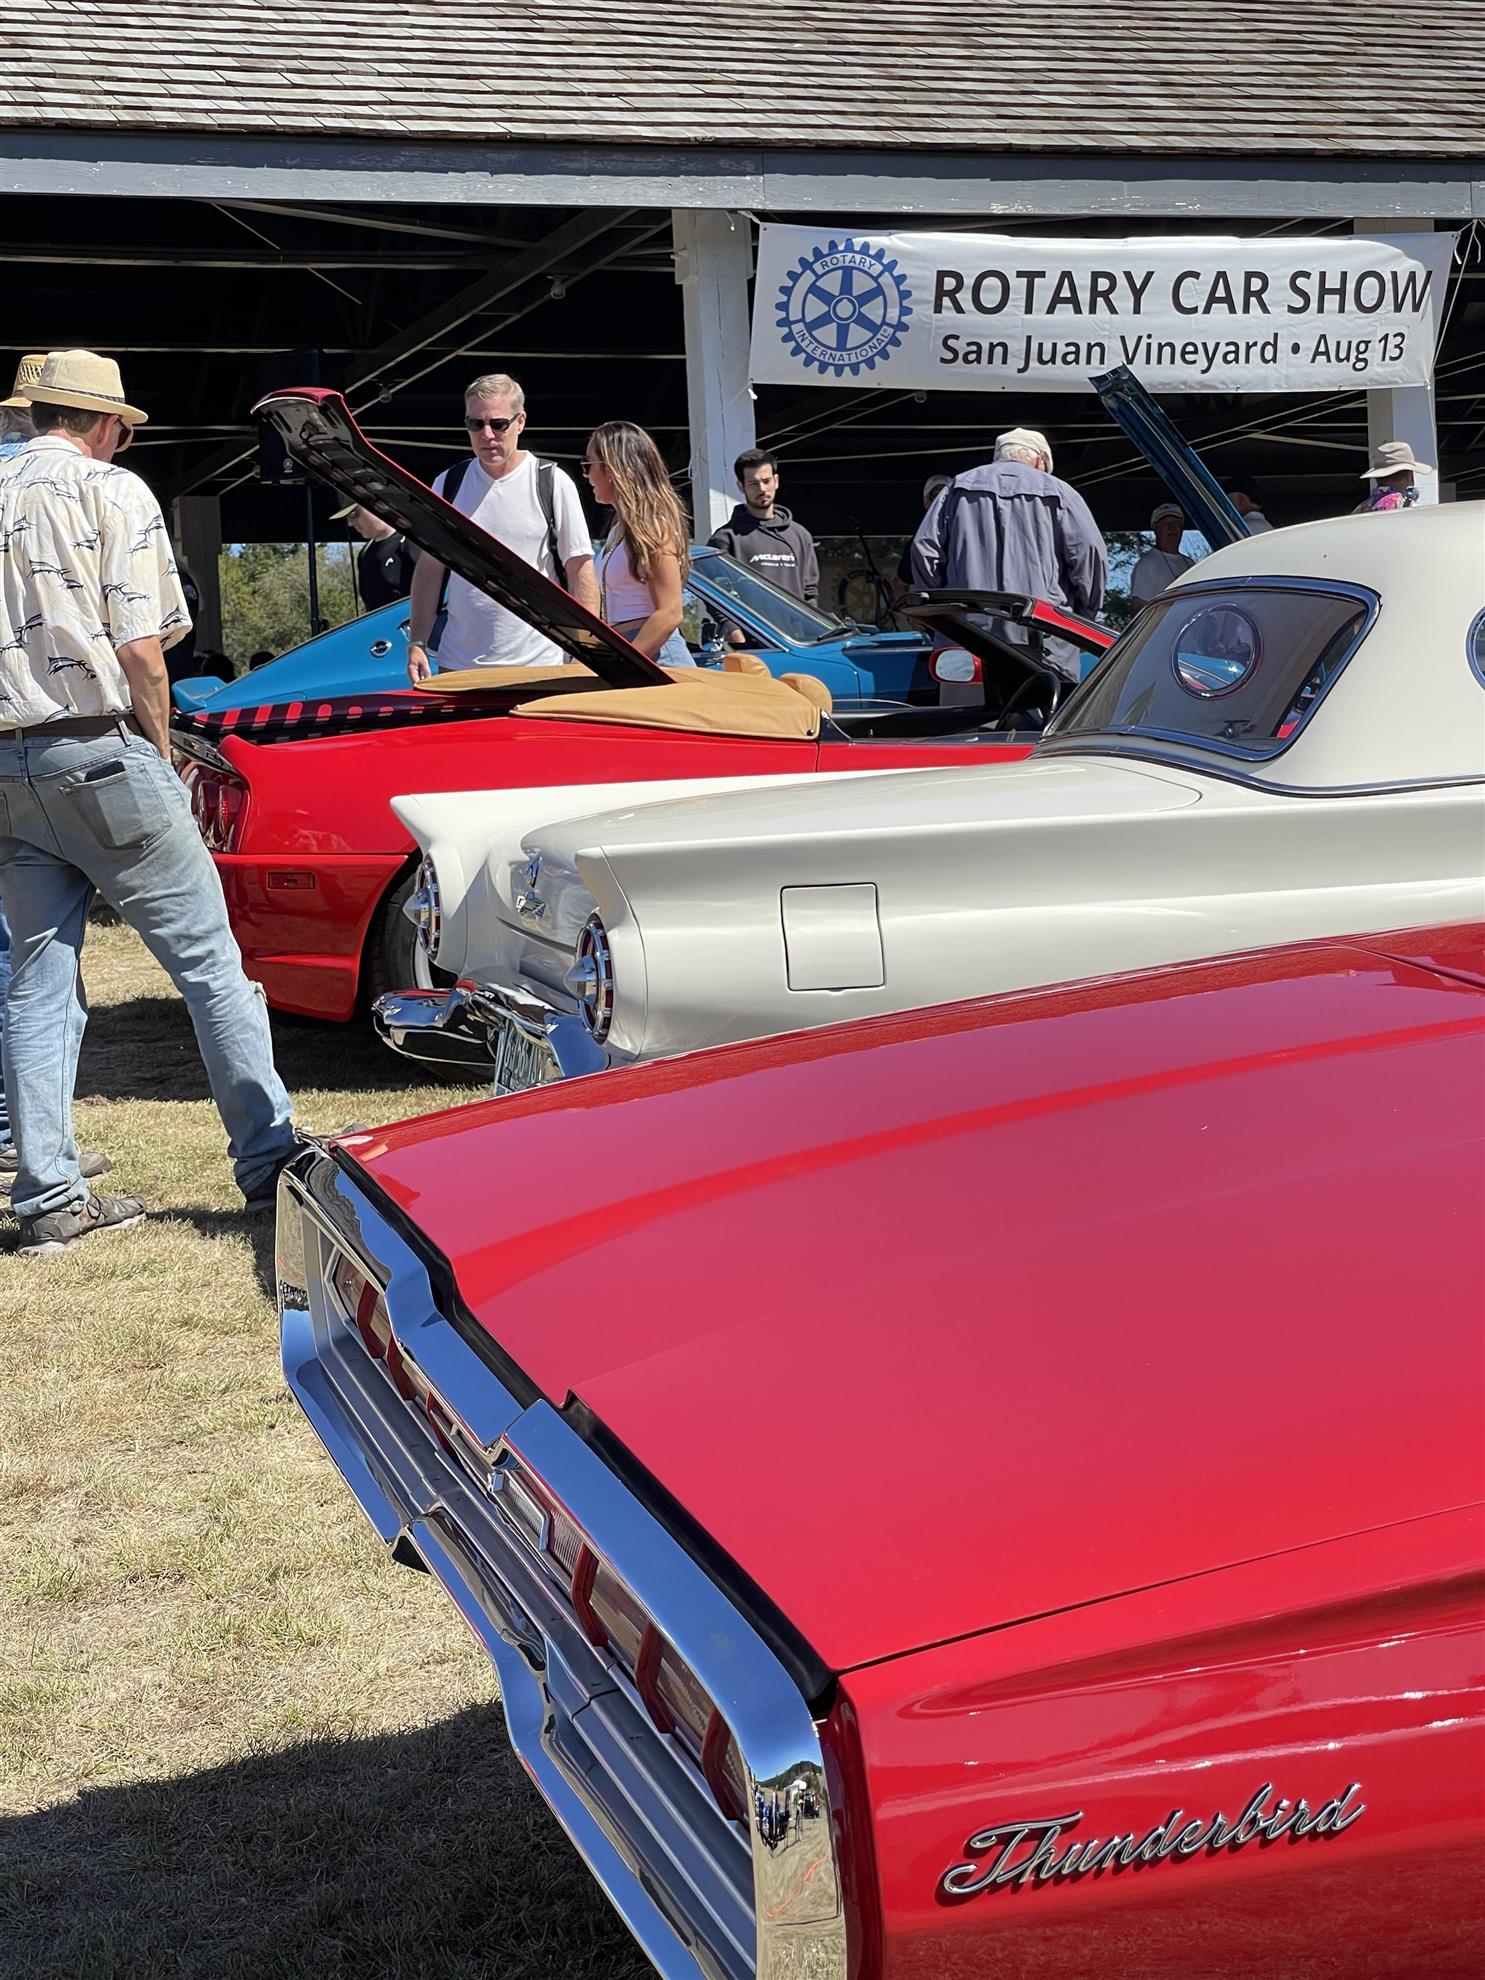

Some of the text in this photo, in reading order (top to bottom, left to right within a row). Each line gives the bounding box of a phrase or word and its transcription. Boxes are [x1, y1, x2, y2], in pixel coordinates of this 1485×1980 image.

[820, 254, 877, 271] ROTARY
[933, 269, 1433, 315] ROTARY CAR SHOW
[795, 329, 890, 363] INTERNATIONAL
[939, 332, 1406, 375] San Juan Vineyard Aug 13
[943, 1781, 1367, 1896] Thunderbird
